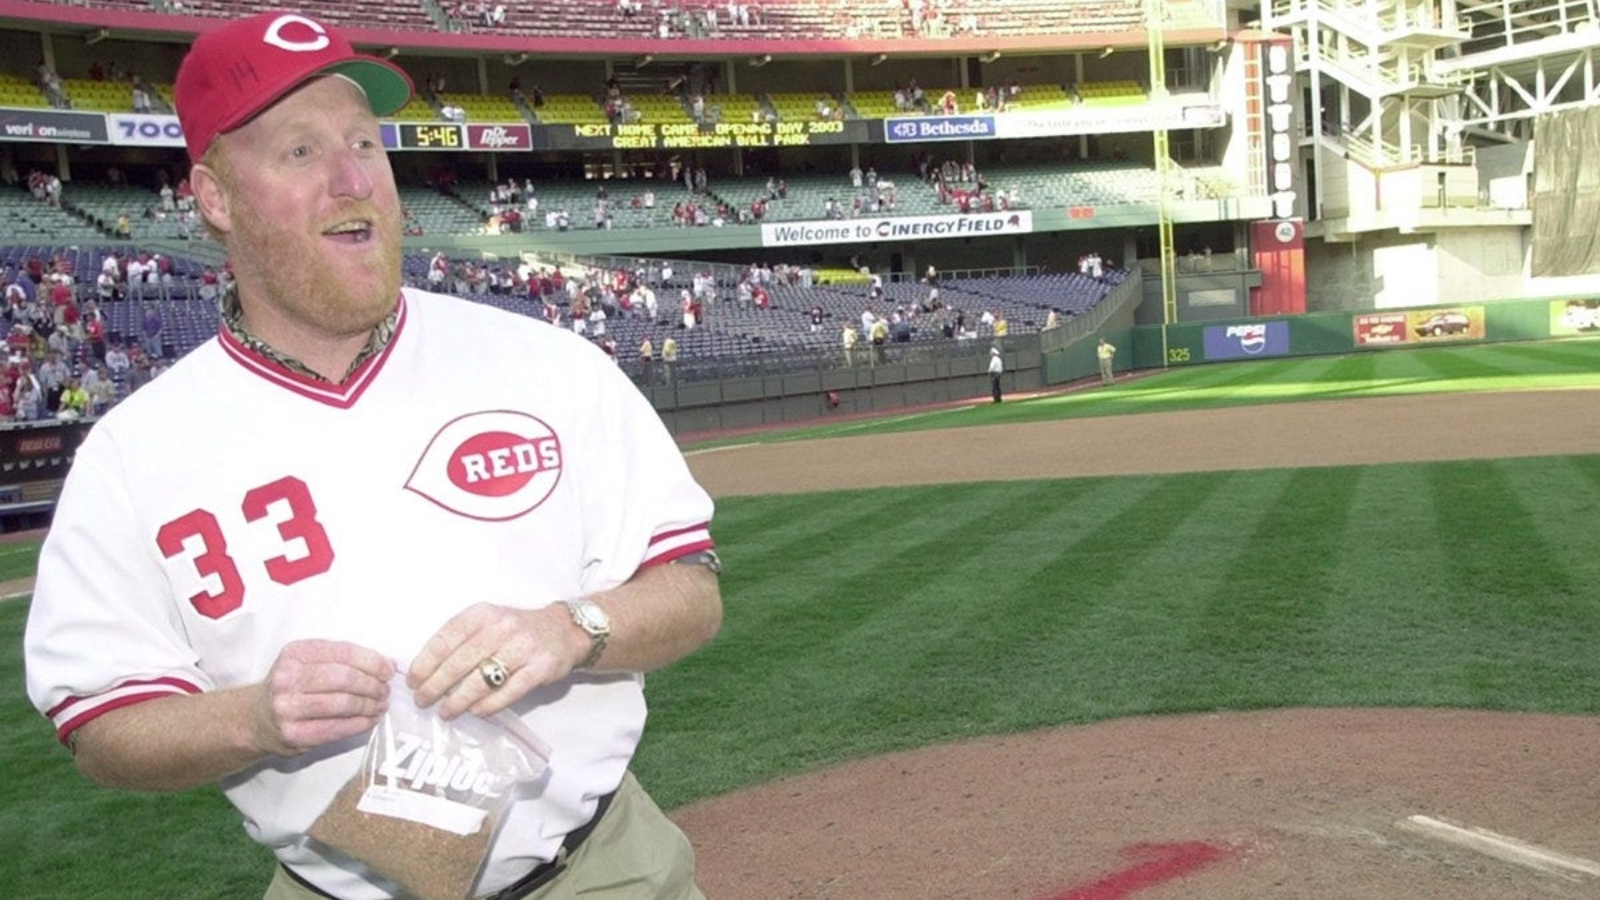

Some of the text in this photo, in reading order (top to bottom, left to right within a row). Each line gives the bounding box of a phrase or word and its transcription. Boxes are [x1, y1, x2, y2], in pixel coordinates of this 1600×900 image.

[264, 14, 330, 52] C
[416, 127, 458, 147] 5:46
[575, 124, 612, 136] NEXT
[617, 124, 656, 136] HOME
[715, 123, 772, 135] OPENING
[775, 122, 804, 134] DAY
[808, 121, 844, 133] 2003
[920, 120, 989, 136] Bethesda
[613, 134, 811, 148] GREAT AMERICAN BALL PARK
[775, 226, 850, 243] Welcome
[856, 225, 872, 238] to
[1168, 348, 1191, 362] 325
[461, 439, 560, 483] REDS
[156, 475, 335, 620] 33
